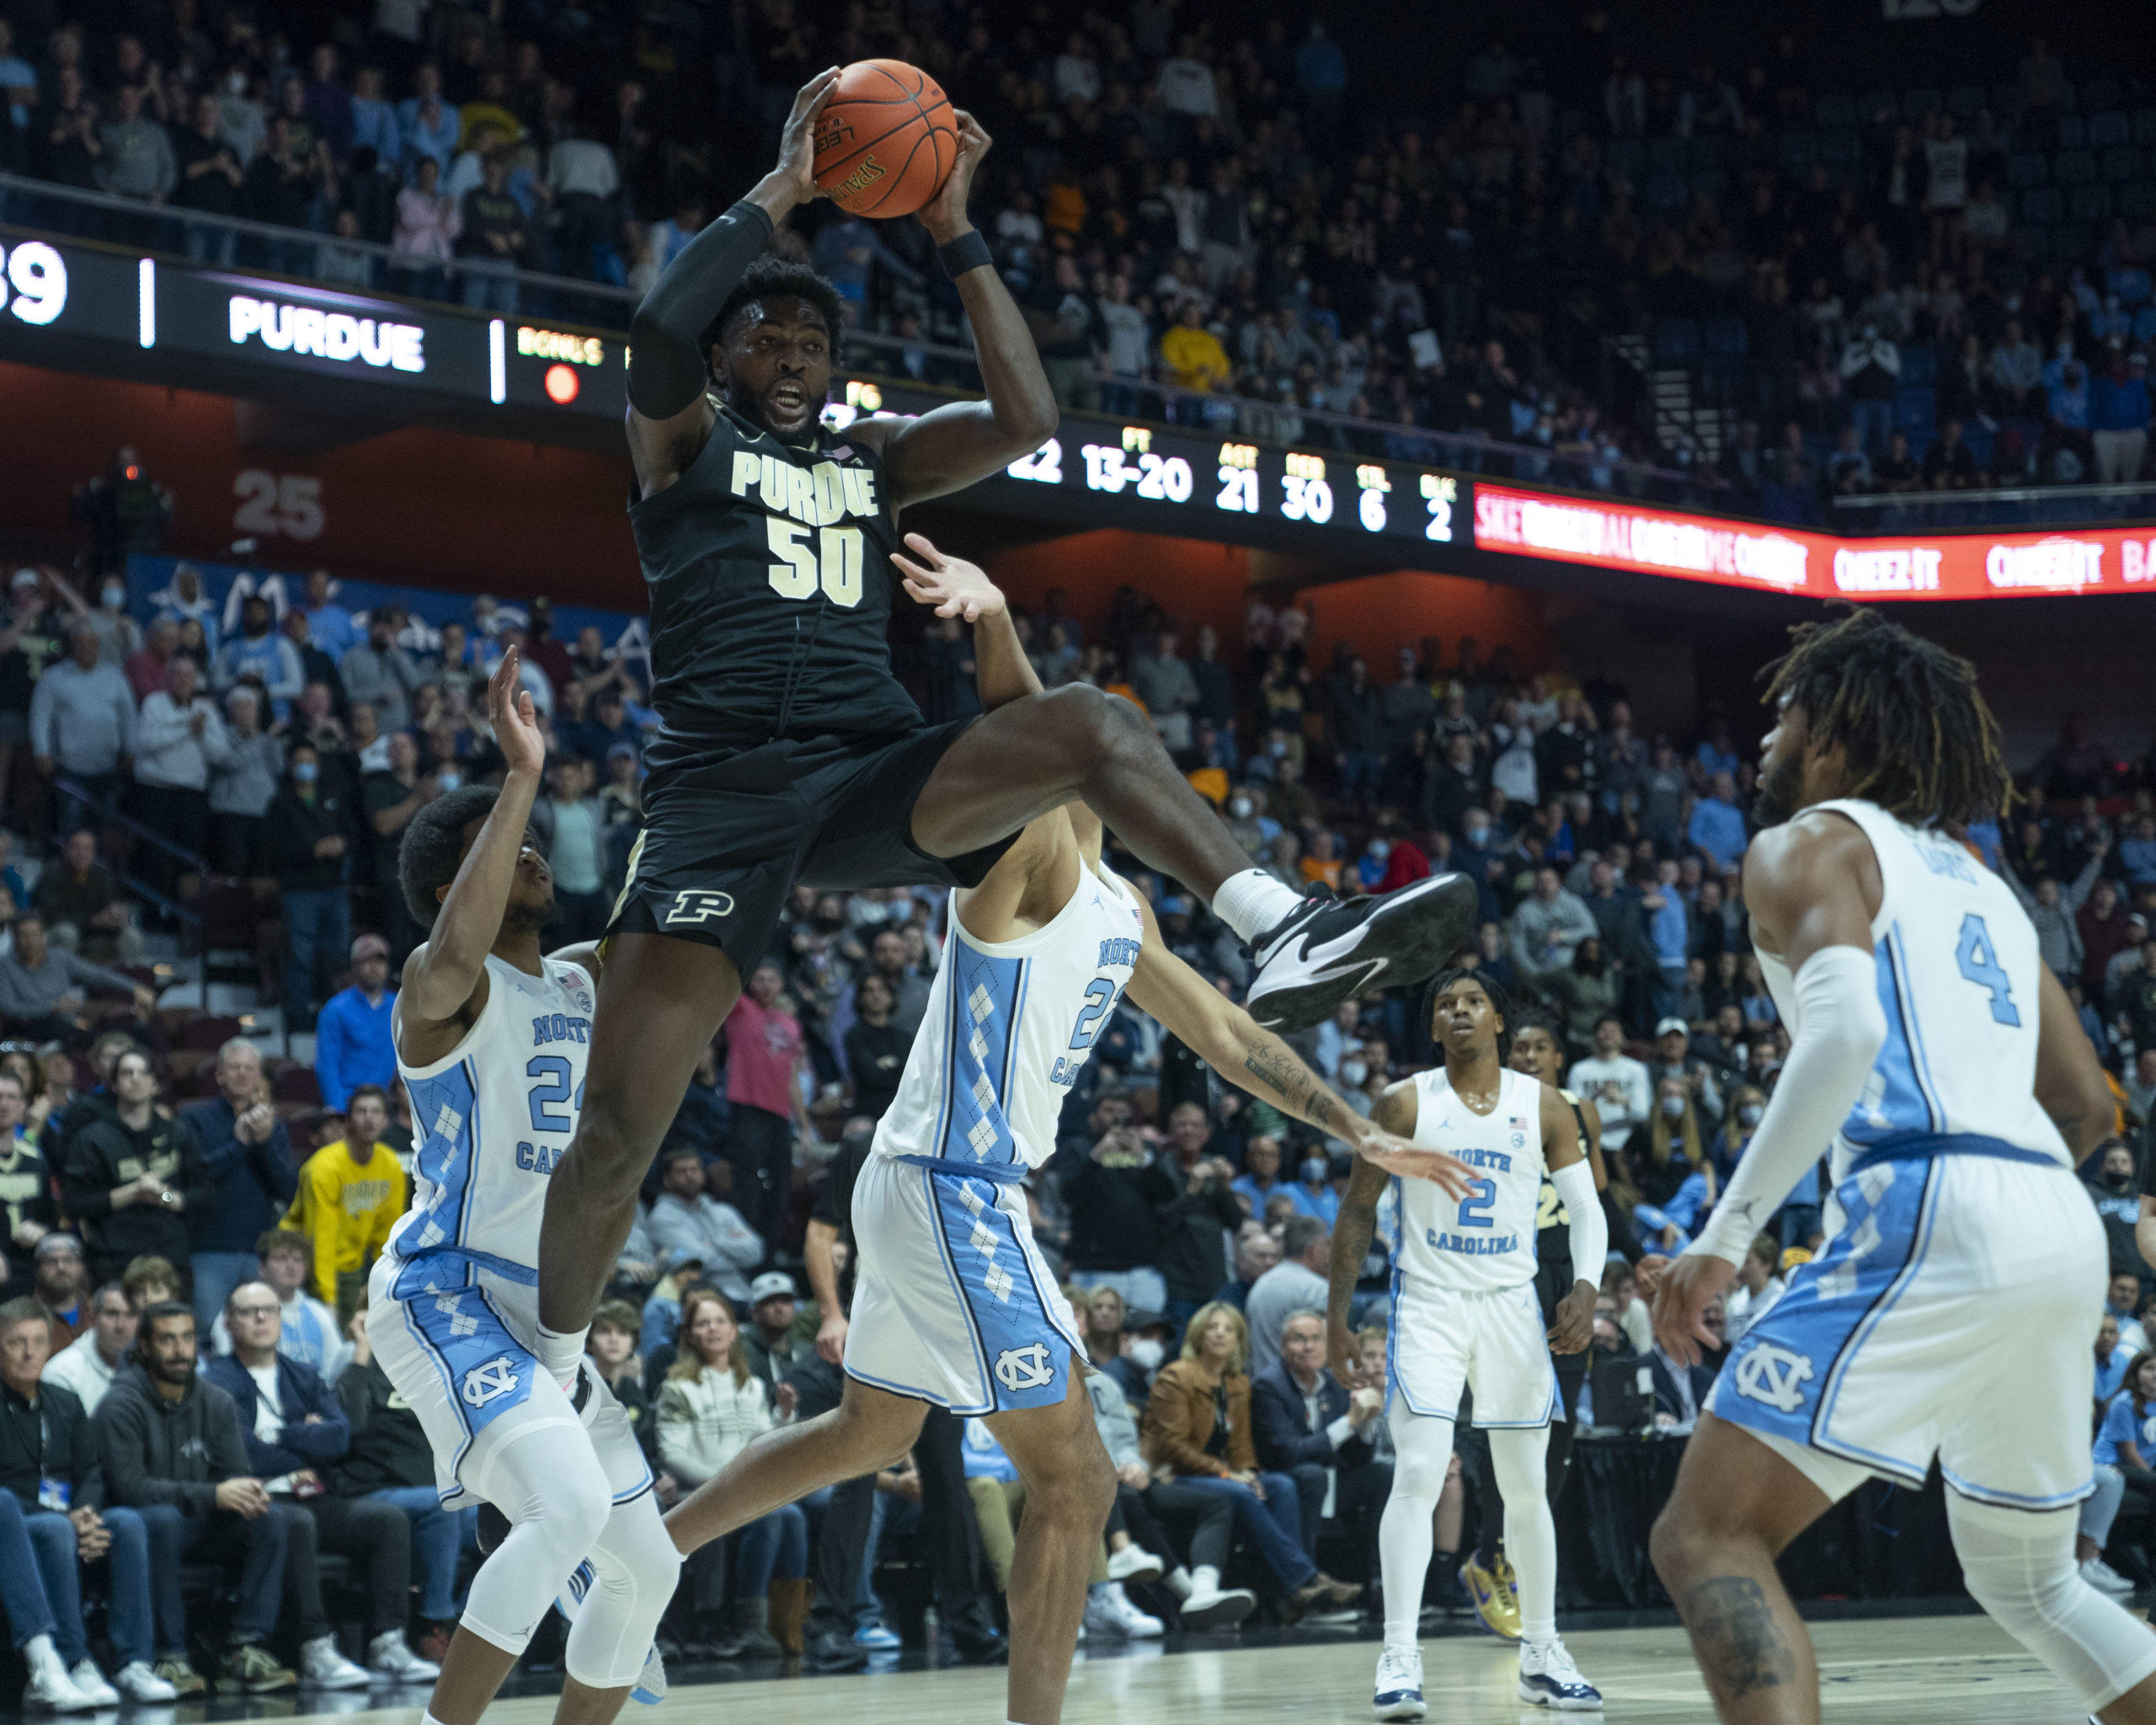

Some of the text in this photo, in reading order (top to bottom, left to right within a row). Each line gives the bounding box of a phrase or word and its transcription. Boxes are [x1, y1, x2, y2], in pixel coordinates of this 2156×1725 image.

[0, 241, 68, 326] 9
[229, 296, 426, 373] PURDUE
[1081, 443, 1193, 504] 13-20
[1216, 465, 1260, 515] 21
[1280, 474, 1334, 524] 30
[233, 468, 325, 541] 25
[1358, 487, 1387, 532] 6
[1425, 498, 1453, 542] 2
[766, 515, 864, 608] 50
[1097, 937, 1142, 969] NORT
[1956, 912, 2022, 1028] 4
[532, 1012, 592, 1046] NOT
[1068, 977, 1128, 1050] 2
[526, 1055, 585, 1133] 2
[1458, 1178, 1497, 1228] 2
[1427, 1228, 1518, 1256] CAROLINA
